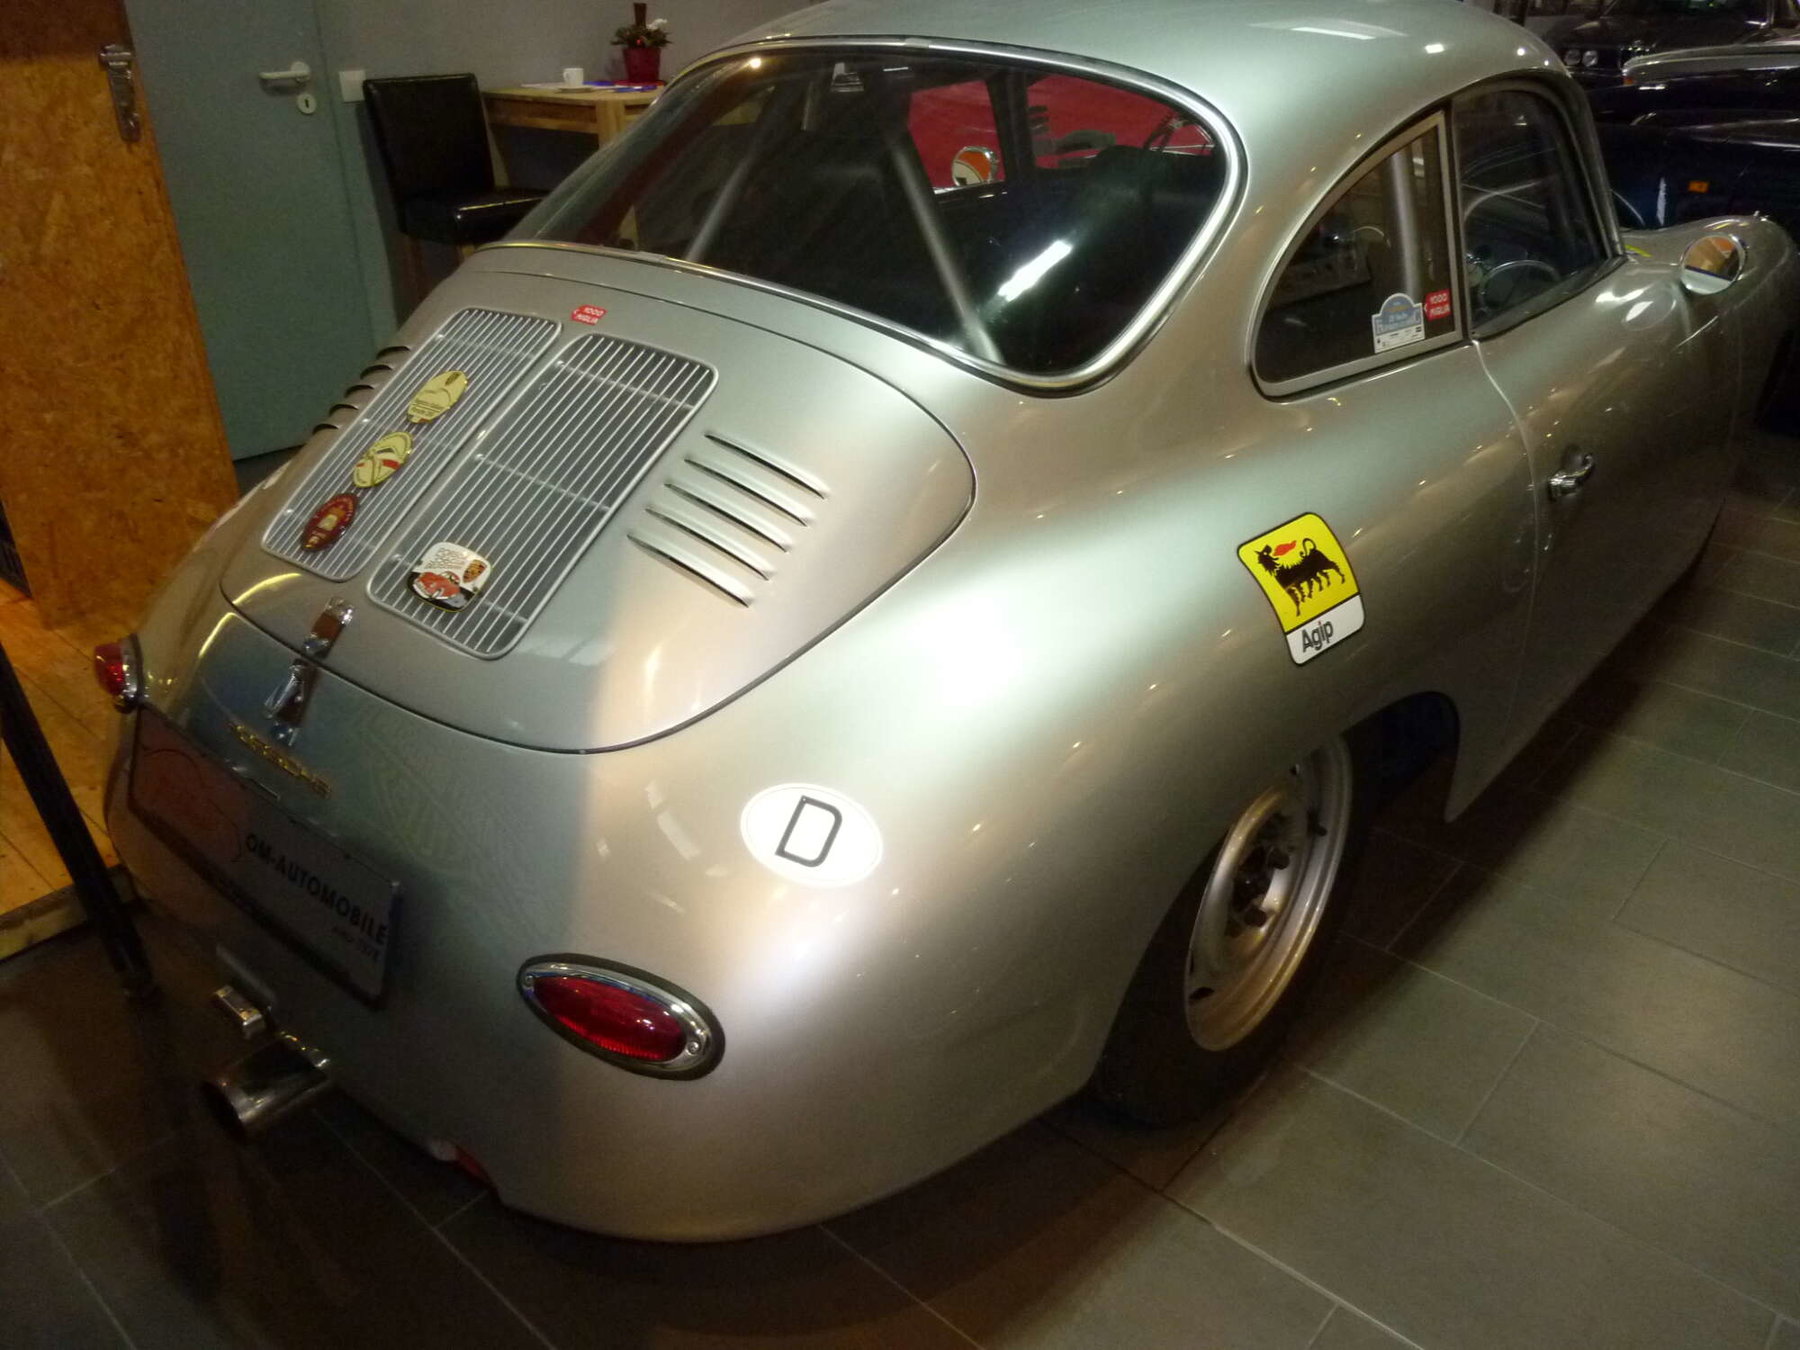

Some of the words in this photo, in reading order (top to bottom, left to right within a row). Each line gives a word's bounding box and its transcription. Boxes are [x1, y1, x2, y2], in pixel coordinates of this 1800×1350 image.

[583, 306, 605, 318] 1000
[1429, 292, 1448, 304] 1000
[1301, 620, 1334, 653] Agip
[775, 795, 842, 867] D
[245, 833, 388, 946] OM-AUTOMOBILE
